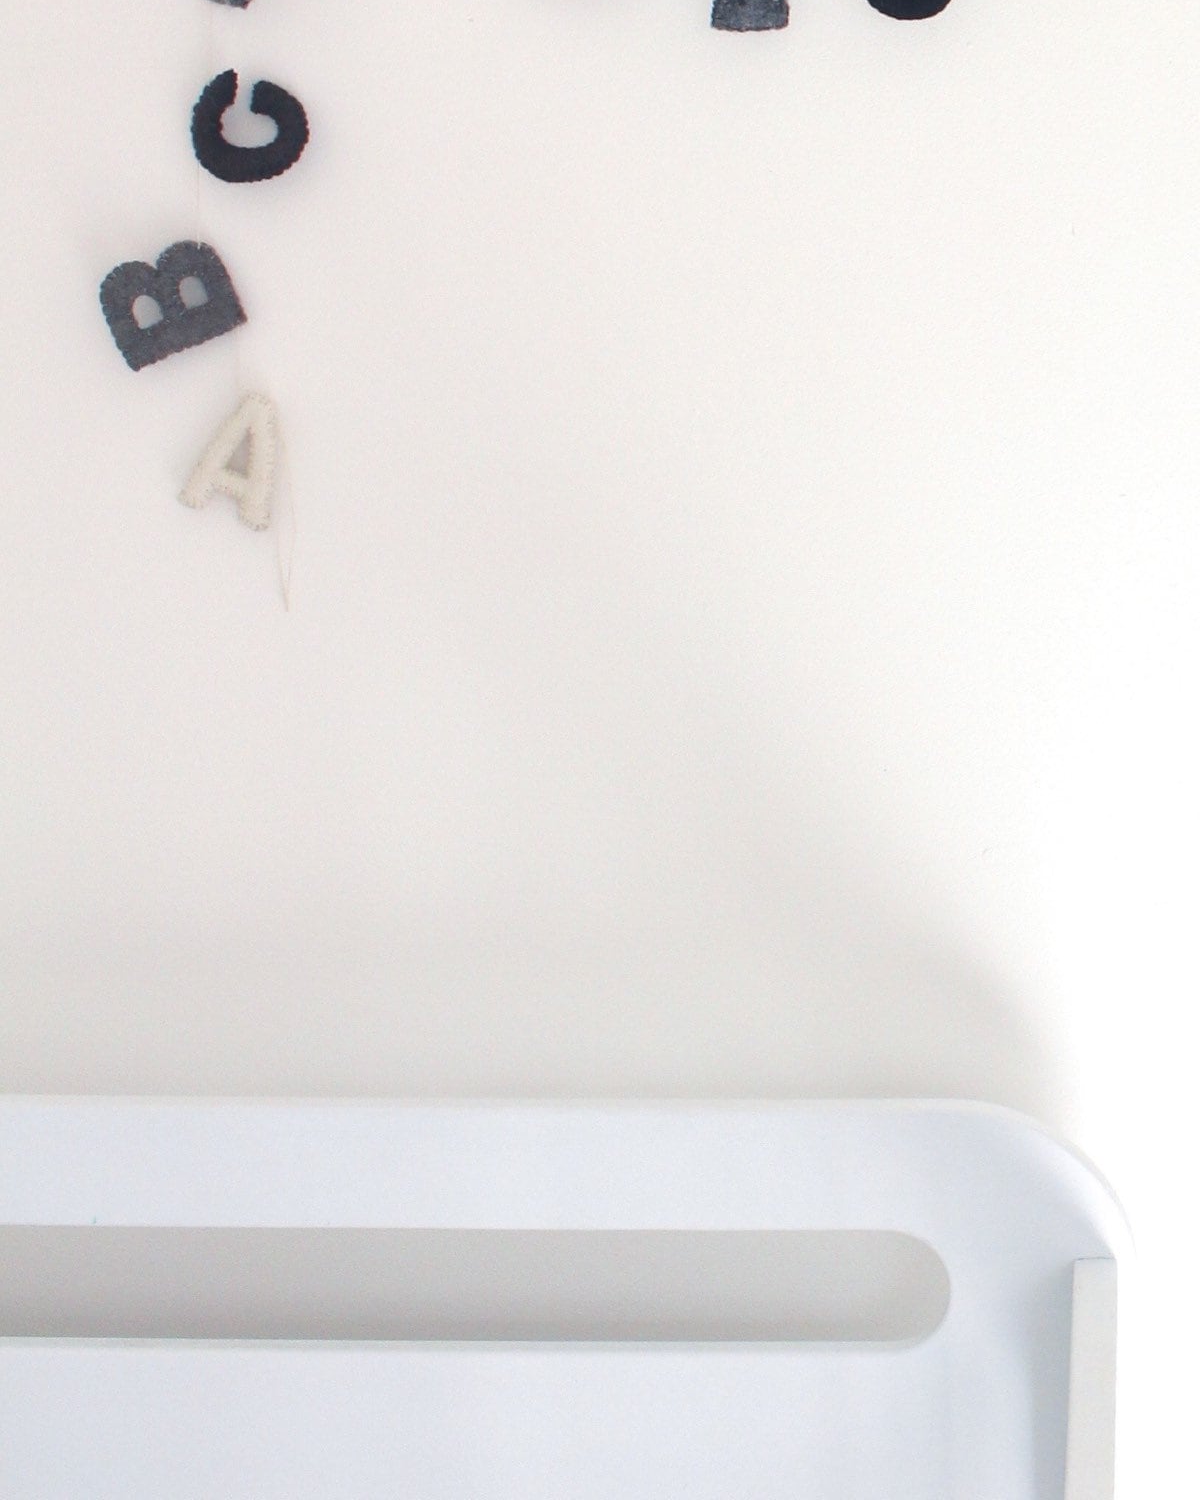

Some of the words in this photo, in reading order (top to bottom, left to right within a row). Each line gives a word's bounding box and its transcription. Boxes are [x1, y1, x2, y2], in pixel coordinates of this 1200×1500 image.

[191, 68, 308, 182] C
[100, 239, 247, 372] B
[178, 392, 277, 532] A
